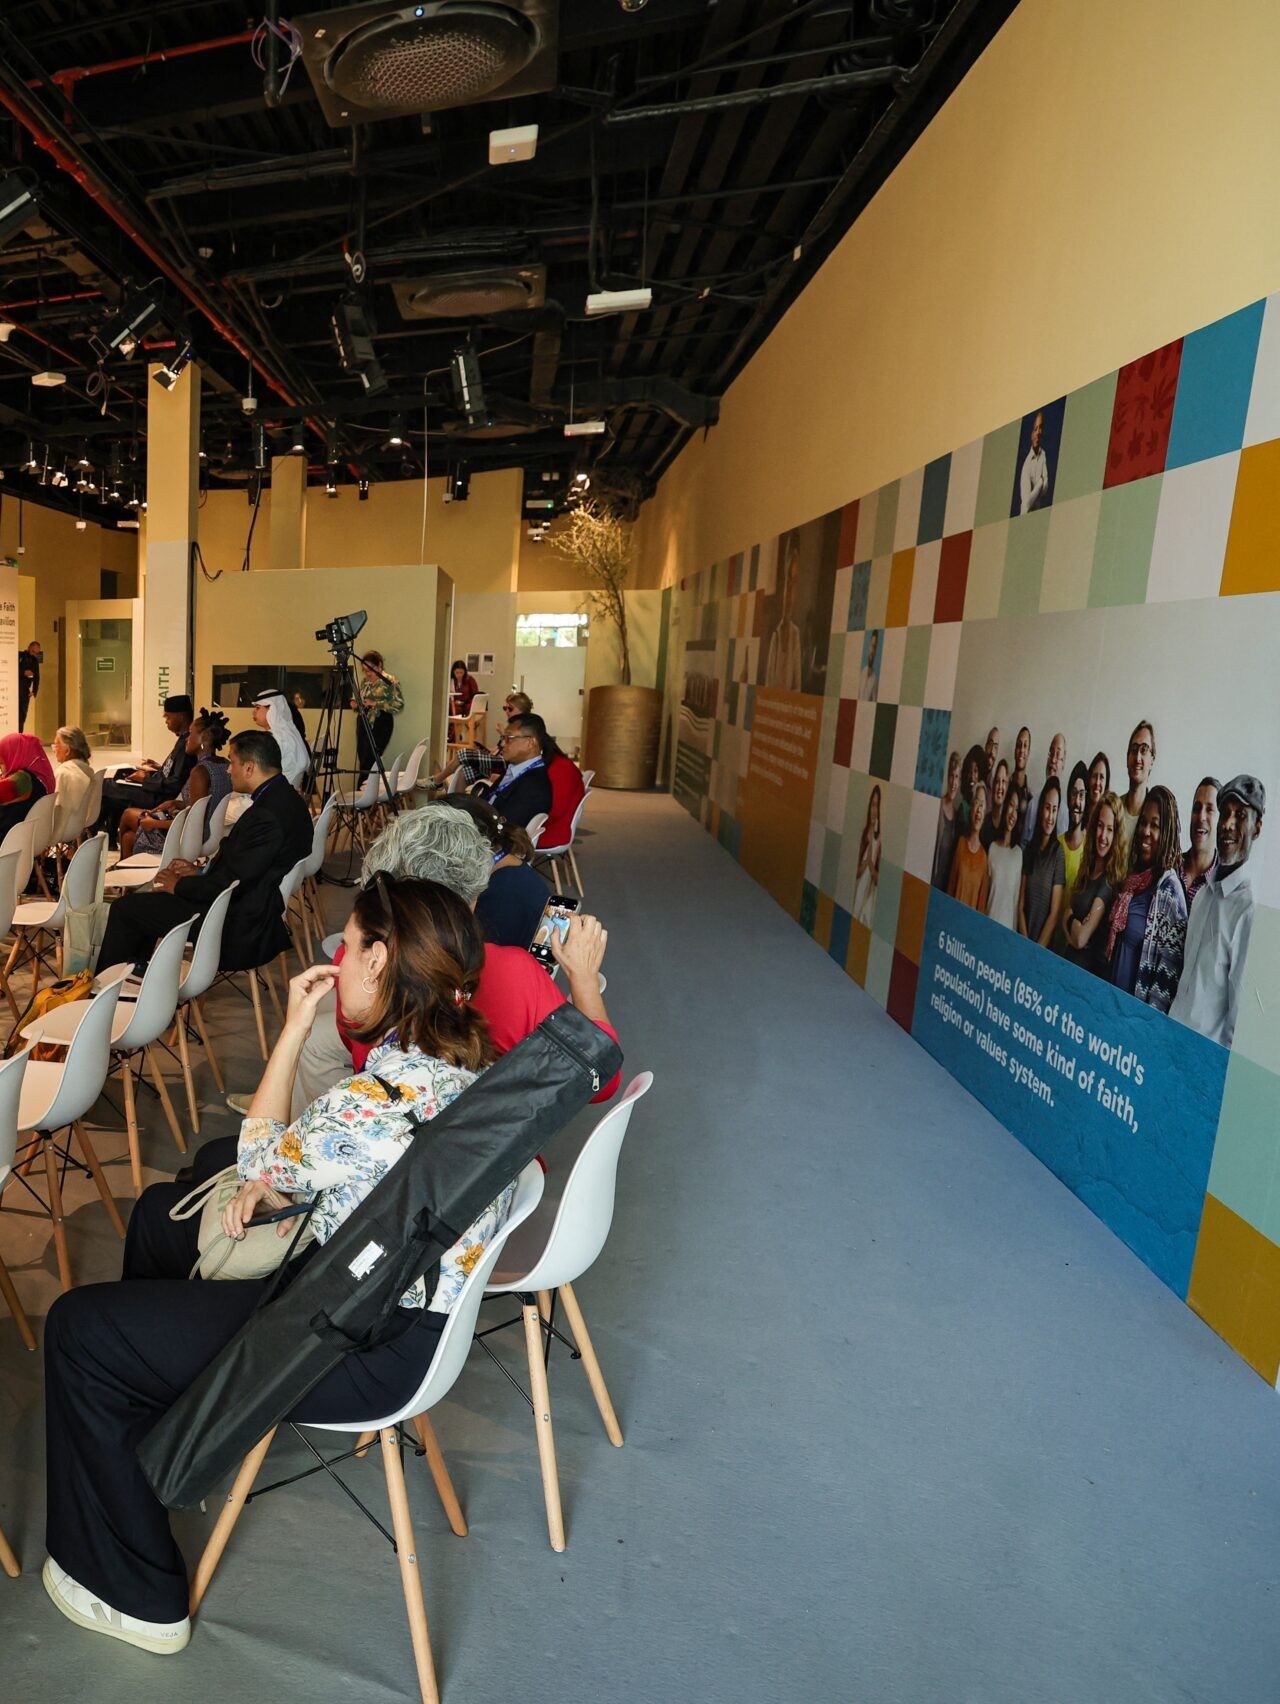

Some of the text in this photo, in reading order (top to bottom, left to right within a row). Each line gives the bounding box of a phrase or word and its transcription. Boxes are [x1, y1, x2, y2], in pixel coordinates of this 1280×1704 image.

[930, 992, 1055, 1108] religion or values system.
[933, 964, 1139, 1134] population) have some kind of faith,
[938, 930, 946, 949] 6
[976, 959, 1012, 995] people
[1013, 977, 1043, 1017] (85%
[1044, 1004, 1060, 1027] of
[1061, 1012, 1085, 1044] the
[1088, 1032, 1145, 1086] world's
